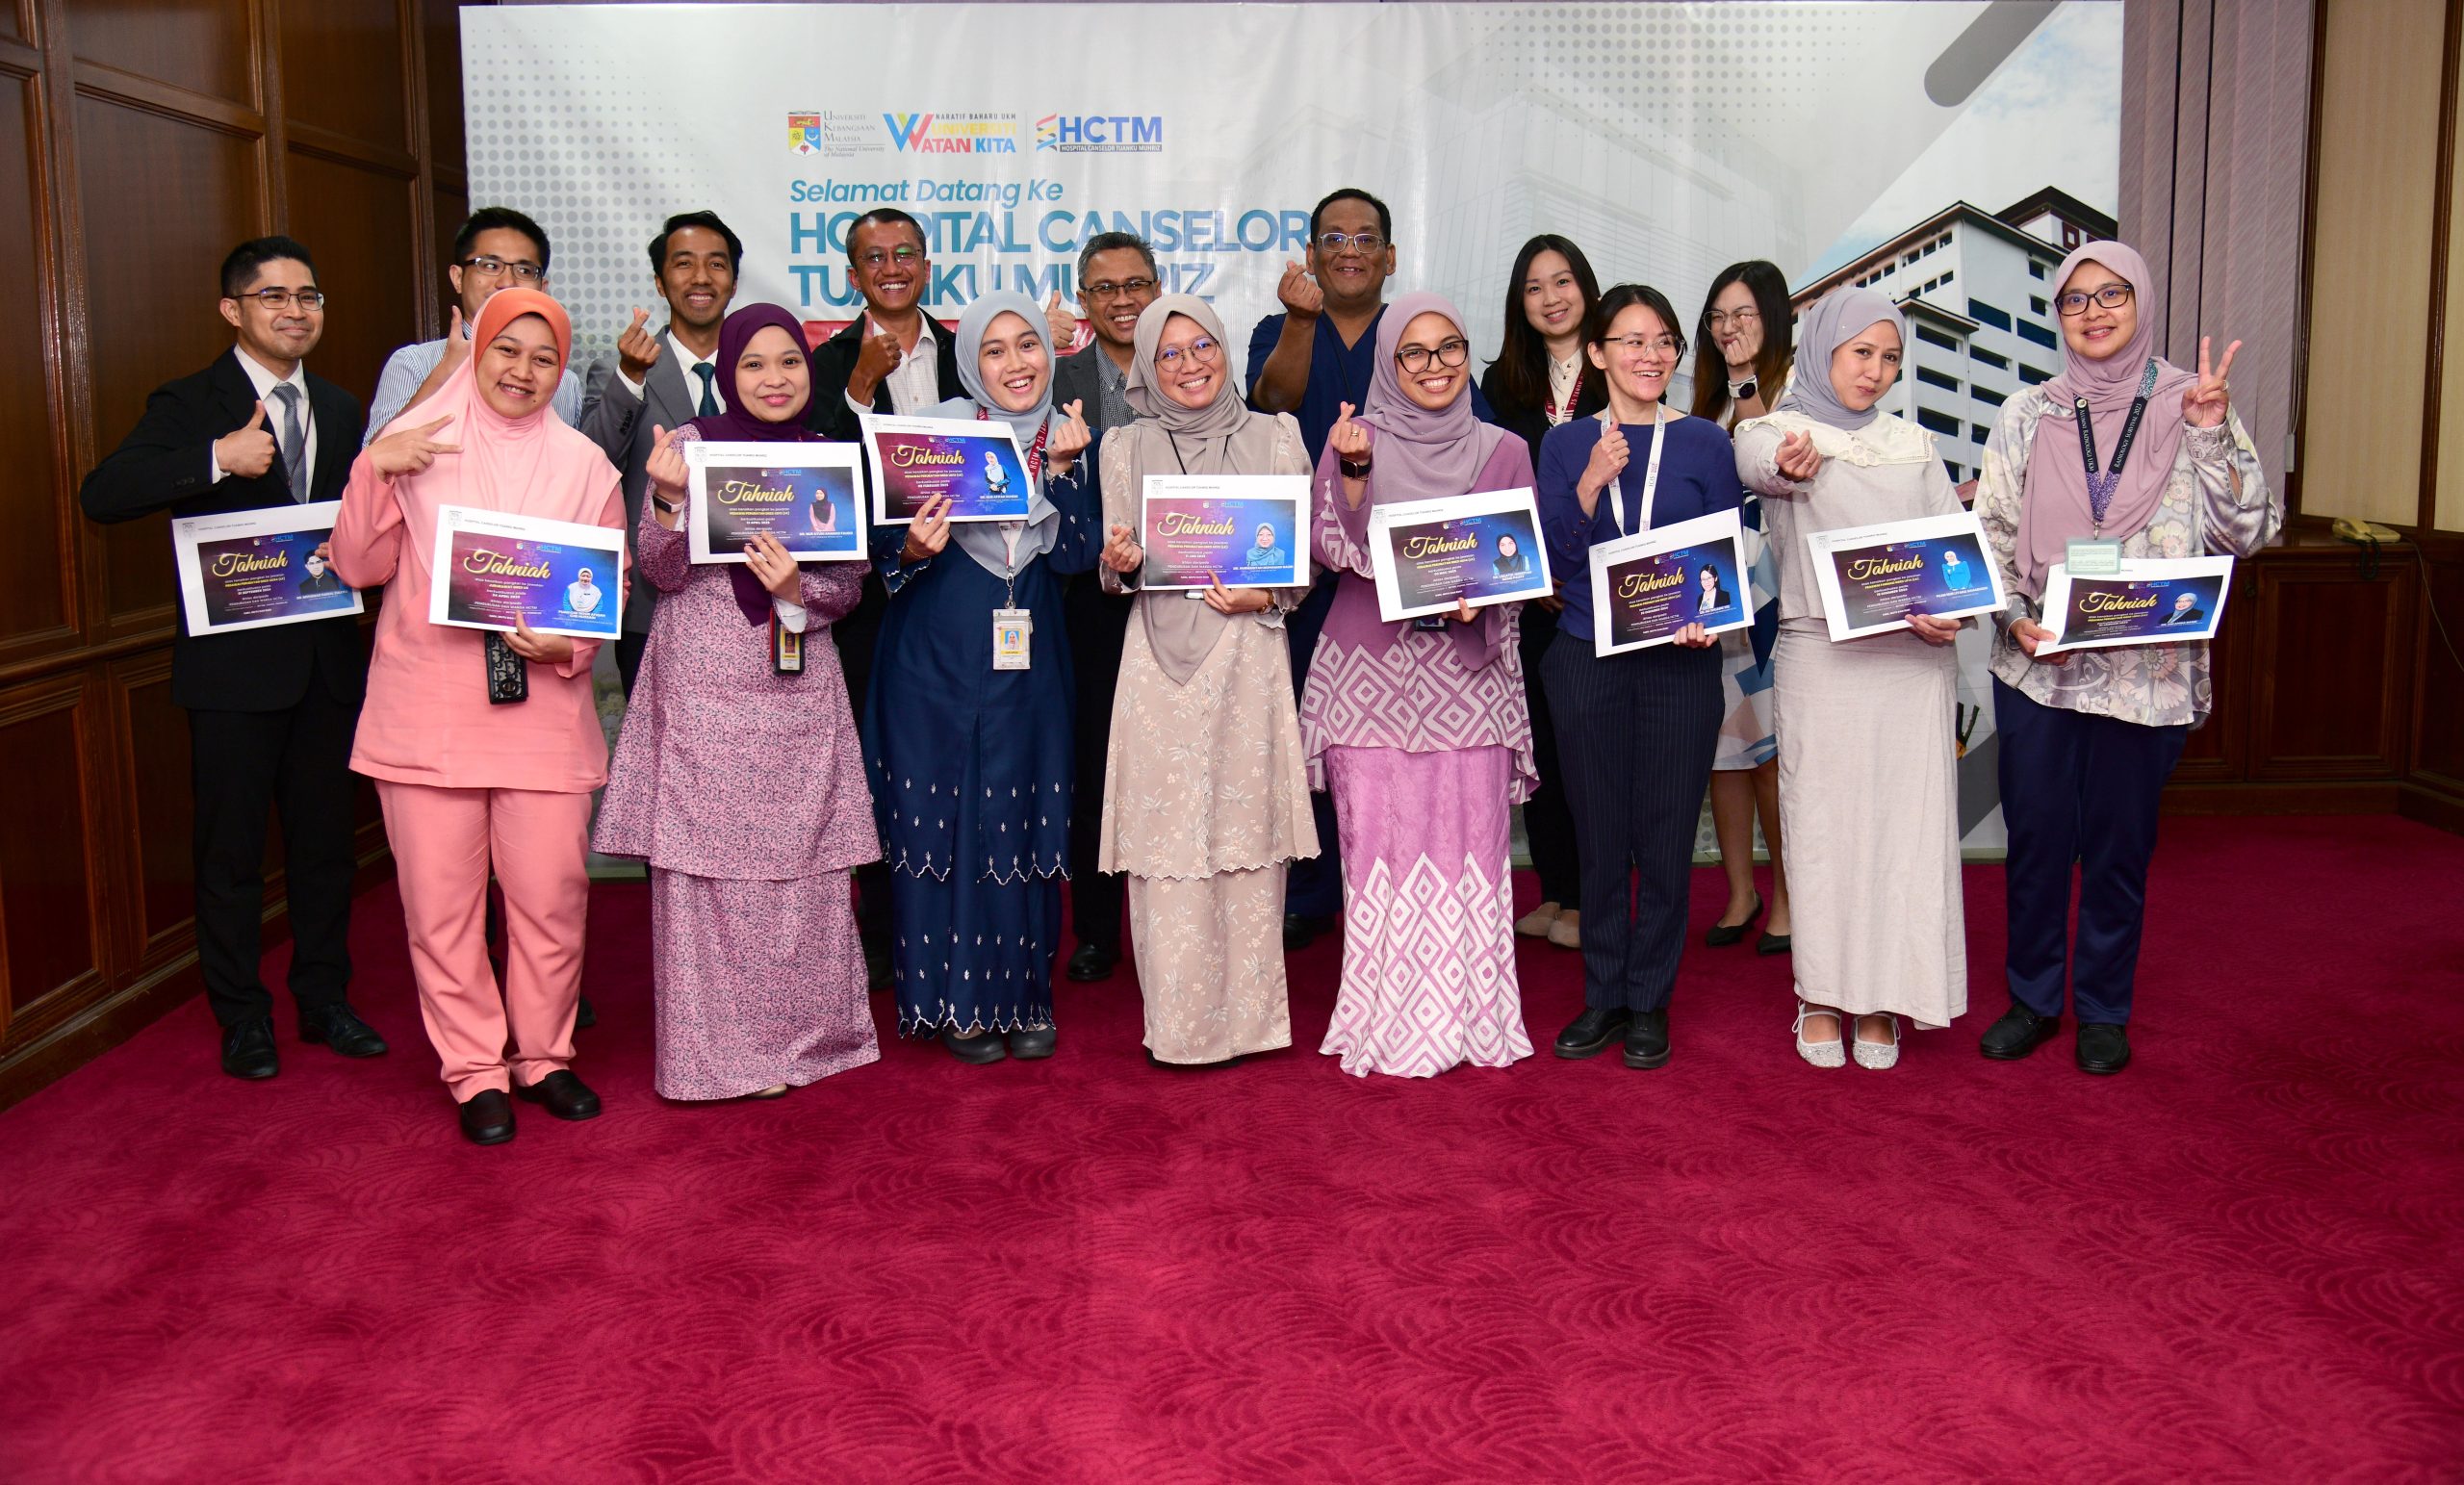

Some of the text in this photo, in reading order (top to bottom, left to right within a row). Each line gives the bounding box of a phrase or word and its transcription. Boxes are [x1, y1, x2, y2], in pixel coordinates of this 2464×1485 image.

[823, 111, 866, 120] UNIVERSITI
[824, 122, 875, 131] KEBANGSAAN
[824, 133, 861, 142] MALAYSIA
[931, 123, 1016, 135] UNIVERSITI
[1059, 116, 1162, 143] HCTM
[976, 138, 1016, 153] KITA
[790, 179, 1064, 209] Selamat Datang Ke
[1038, 209, 1312, 252] CANSELOR
[788, 265, 1002, 307] TUKU
[891, 446, 964, 467] Tahniah
[2083, 430, 2092, 457] RADIOLOGI
[2114, 439, 2129, 468] RADIOLOGY
[718, 480, 794, 503] Tahniah
[1157, 512, 1234, 536] Tahniah
[1403, 532, 1477, 559] Tahniah
[212, 550, 288, 577] Tahniah
[463, 549, 552, 578] Tahniah
[1847, 554, 1924, 580] Tahniah
[1618, 567, 1684, 598] Tahniah
[2079, 592, 2157, 612] Tahniah
